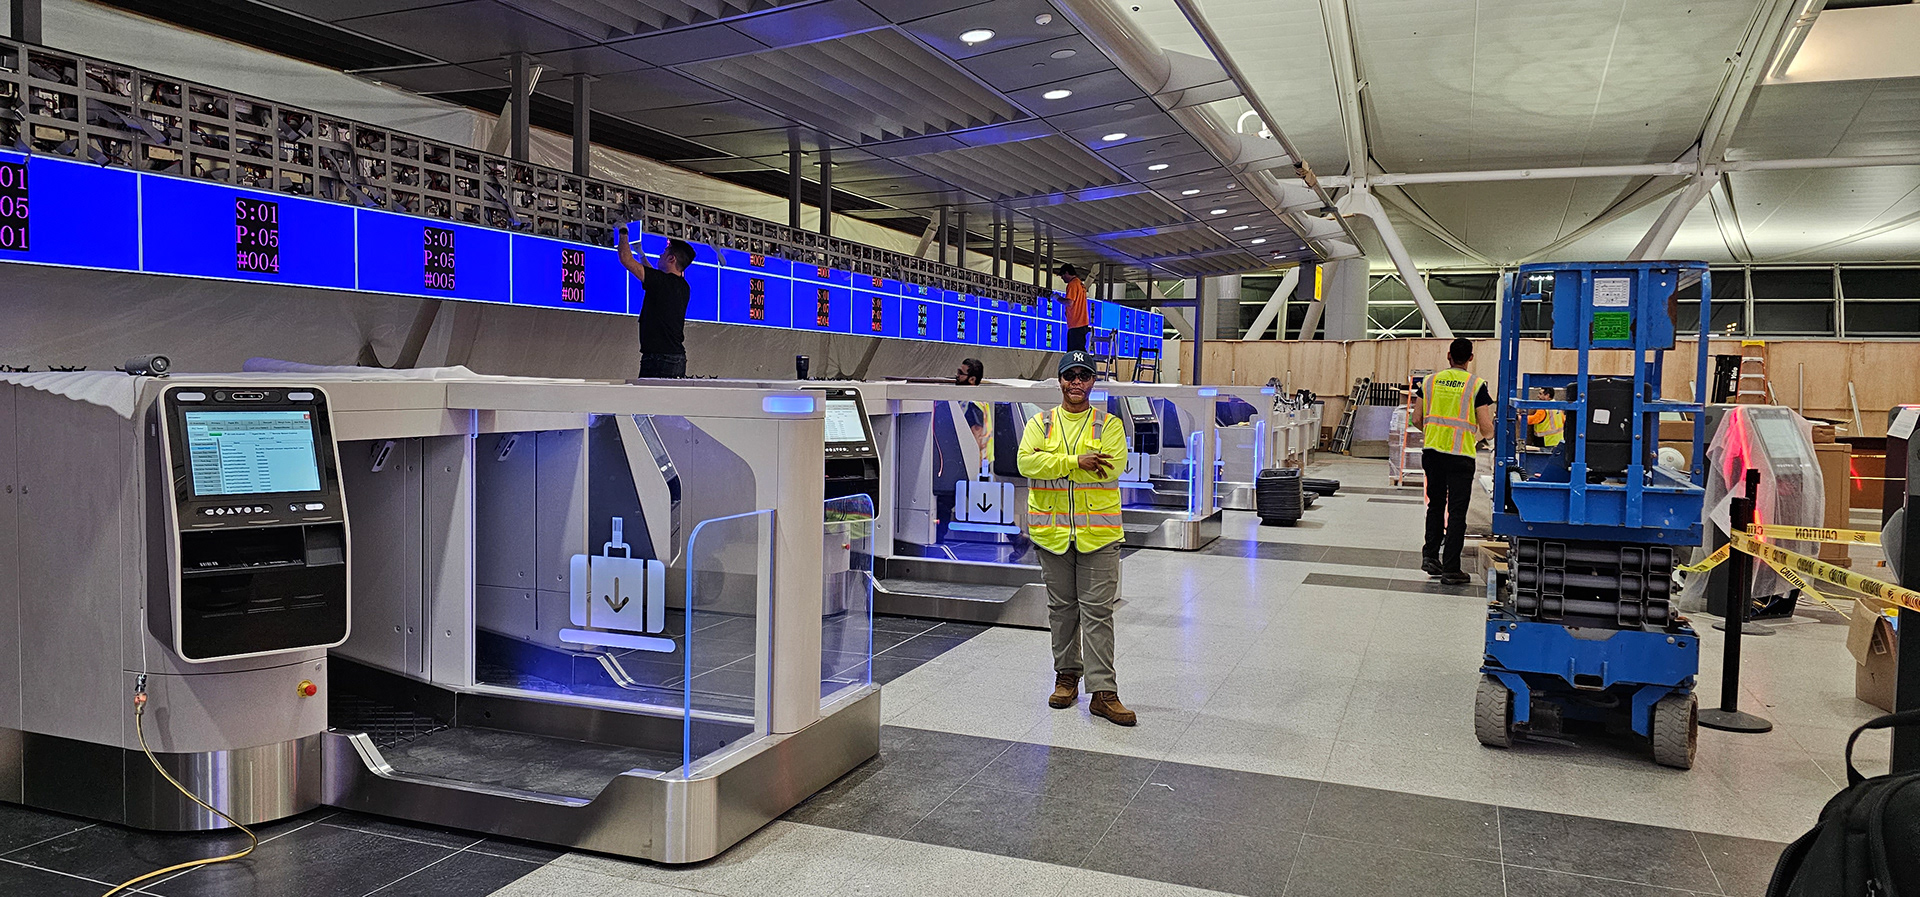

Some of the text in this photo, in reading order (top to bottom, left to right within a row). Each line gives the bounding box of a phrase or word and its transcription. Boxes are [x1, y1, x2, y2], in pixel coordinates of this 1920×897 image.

[236, 200, 277, 224] S:01
[236, 224, 279, 248] P:05
[424, 229, 454, 248] S:01
[237, 250, 279, 272] #004
[424, 249, 455, 269] P:05
[562, 250, 584, 267] S:01
[750, 254, 764, 267] #002
[425, 271, 455, 290] #005
[561, 268, 585, 284] P:06
[562, 286, 584, 302] #001
[750, 279, 764, 292] S:01
[750, 293, 764, 305] P:07
[750, 308, 764, 320] #001
[1073, 352, 1084, 361] NY
[1779, 566, 1806, 589] CAUTION
